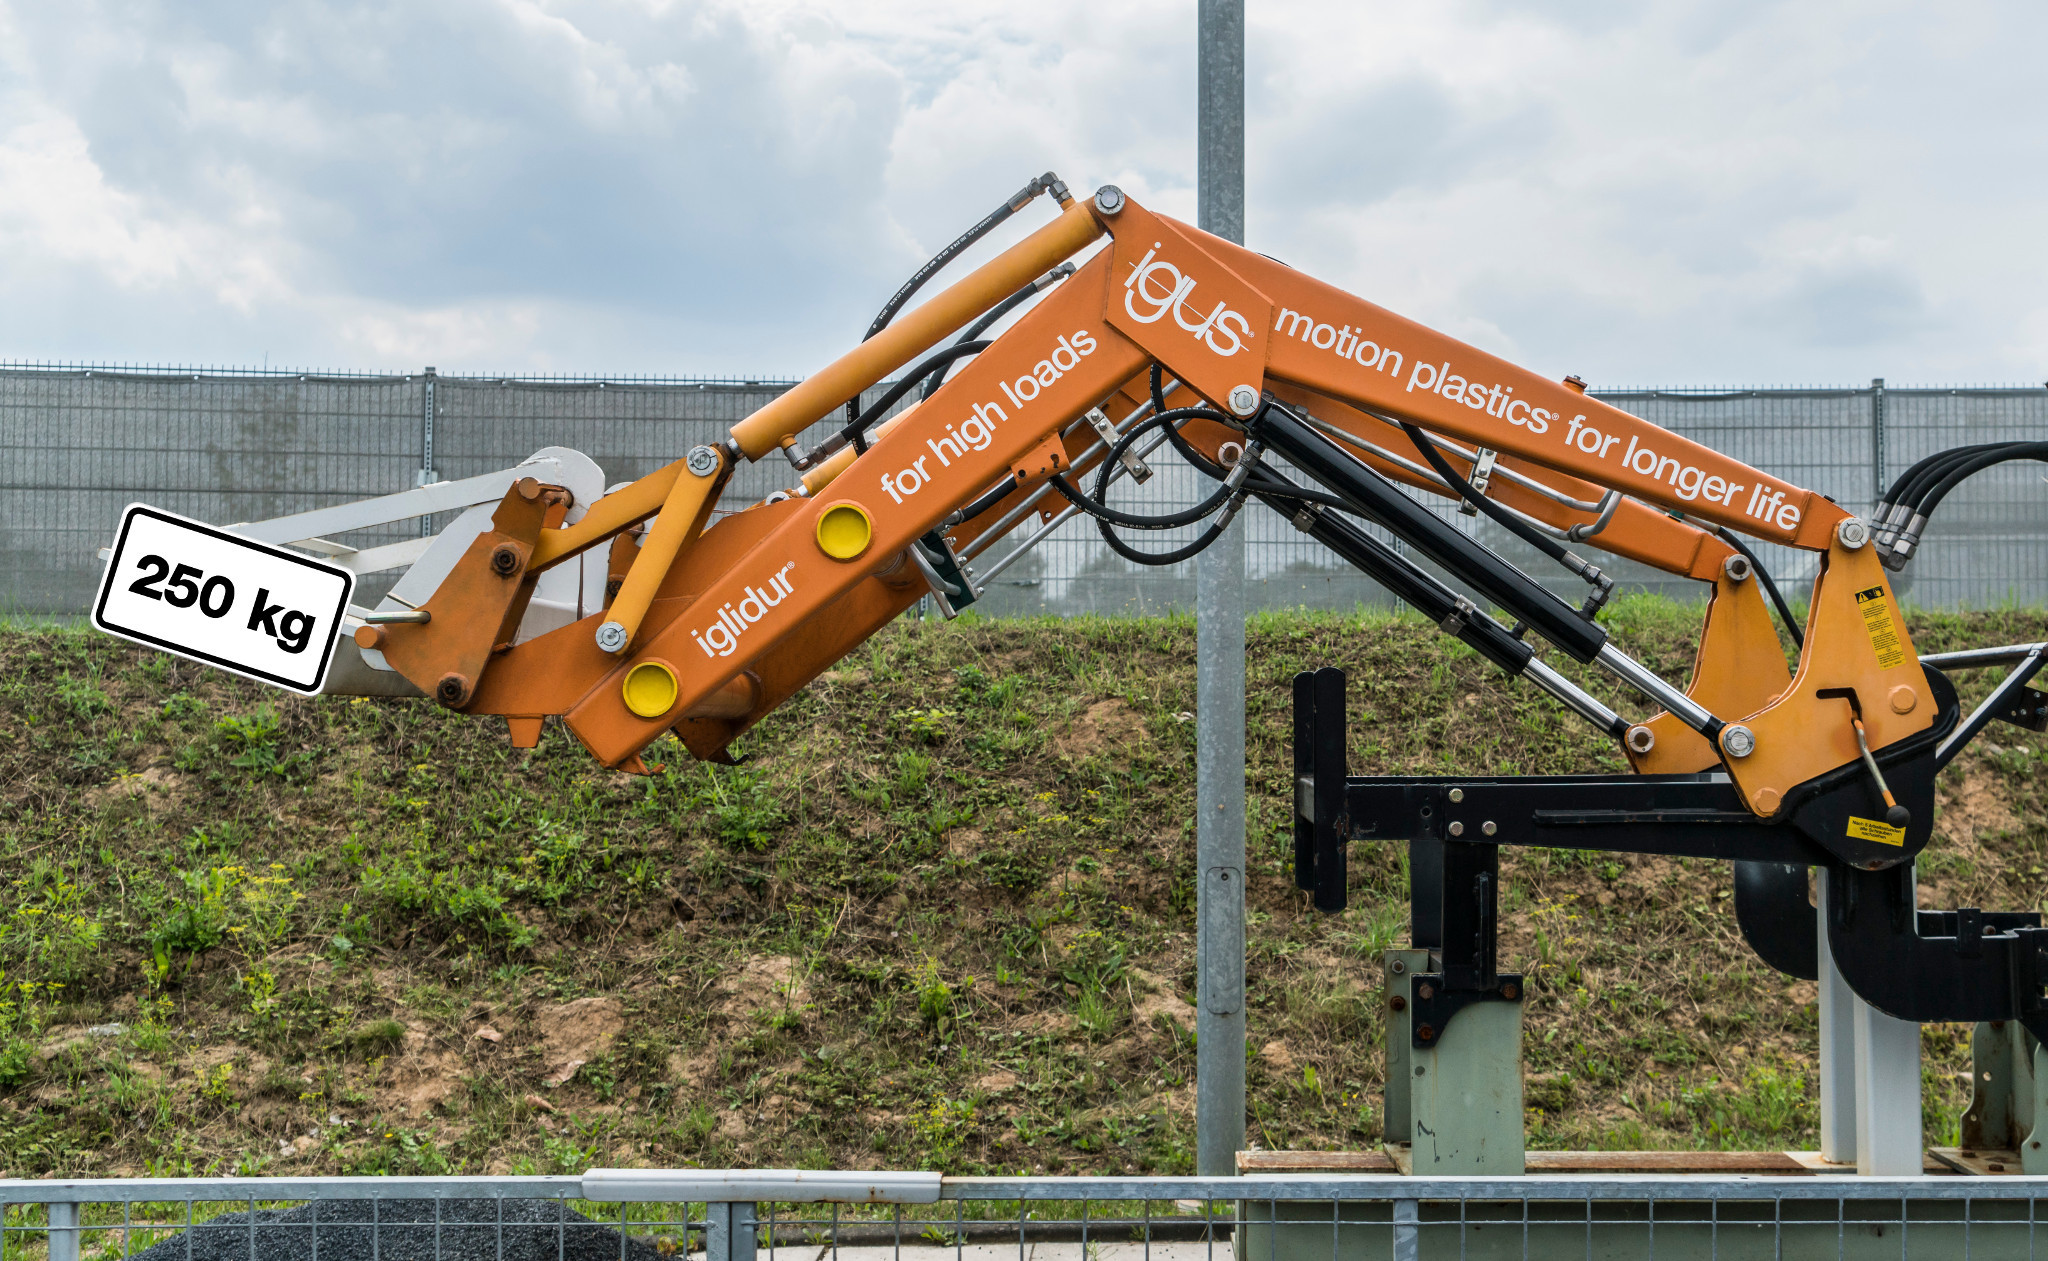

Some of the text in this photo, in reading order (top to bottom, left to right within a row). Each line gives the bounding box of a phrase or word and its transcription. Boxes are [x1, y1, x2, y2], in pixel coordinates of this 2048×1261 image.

[881, 455, 931, 504] for
[927, 402, 1008, 467] high
[999, 330, 1097, 409] loads
[1275, 308, 1403, 377] motion
[1565, 415, 1620, 458] for
[1622, 435, 1744, 506] longer
[1746, 483, 1801, 530] life
[129, 555, 316, 653] 250 kg
[1869, 827, 1892, 836] Schrauben
